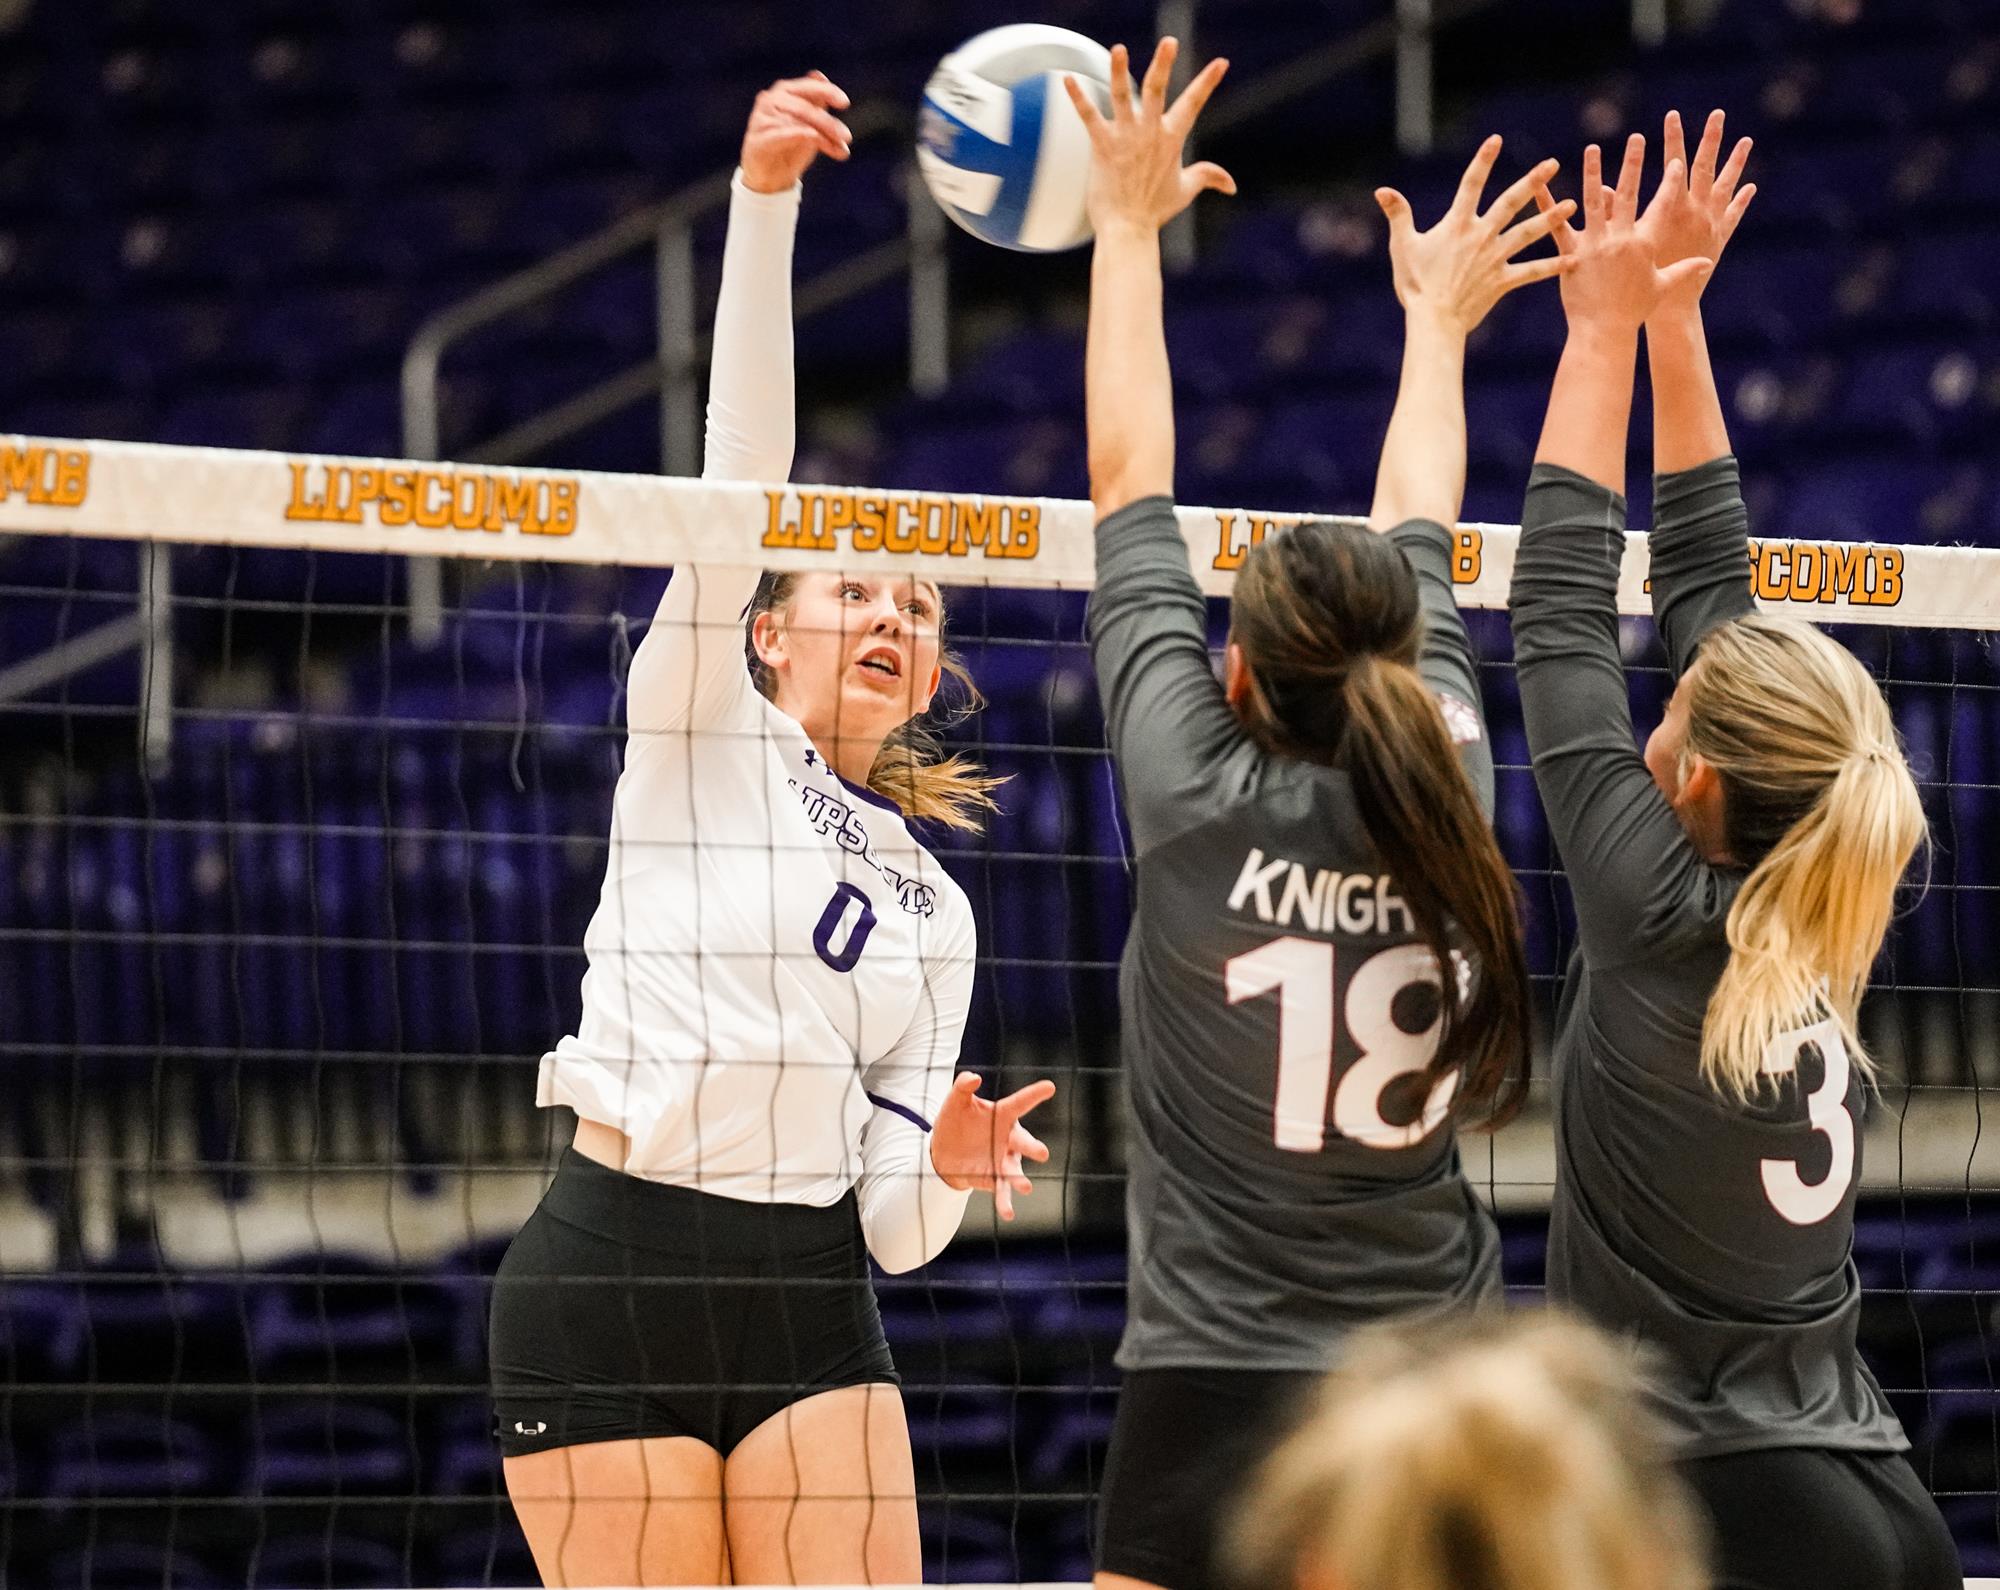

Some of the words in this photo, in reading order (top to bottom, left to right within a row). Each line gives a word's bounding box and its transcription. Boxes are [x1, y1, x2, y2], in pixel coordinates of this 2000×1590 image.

[284, 461, 579, 536] LIPSCOMB
[761, 489, 1041, 560] LIPSCOMB
[812, 880, 879, 973] 0
[1227, 847, 1417, 935] KNIGH
[1225, 935, 1472, 1153] 18
[1759, 1016, 1855, 1227] 3
